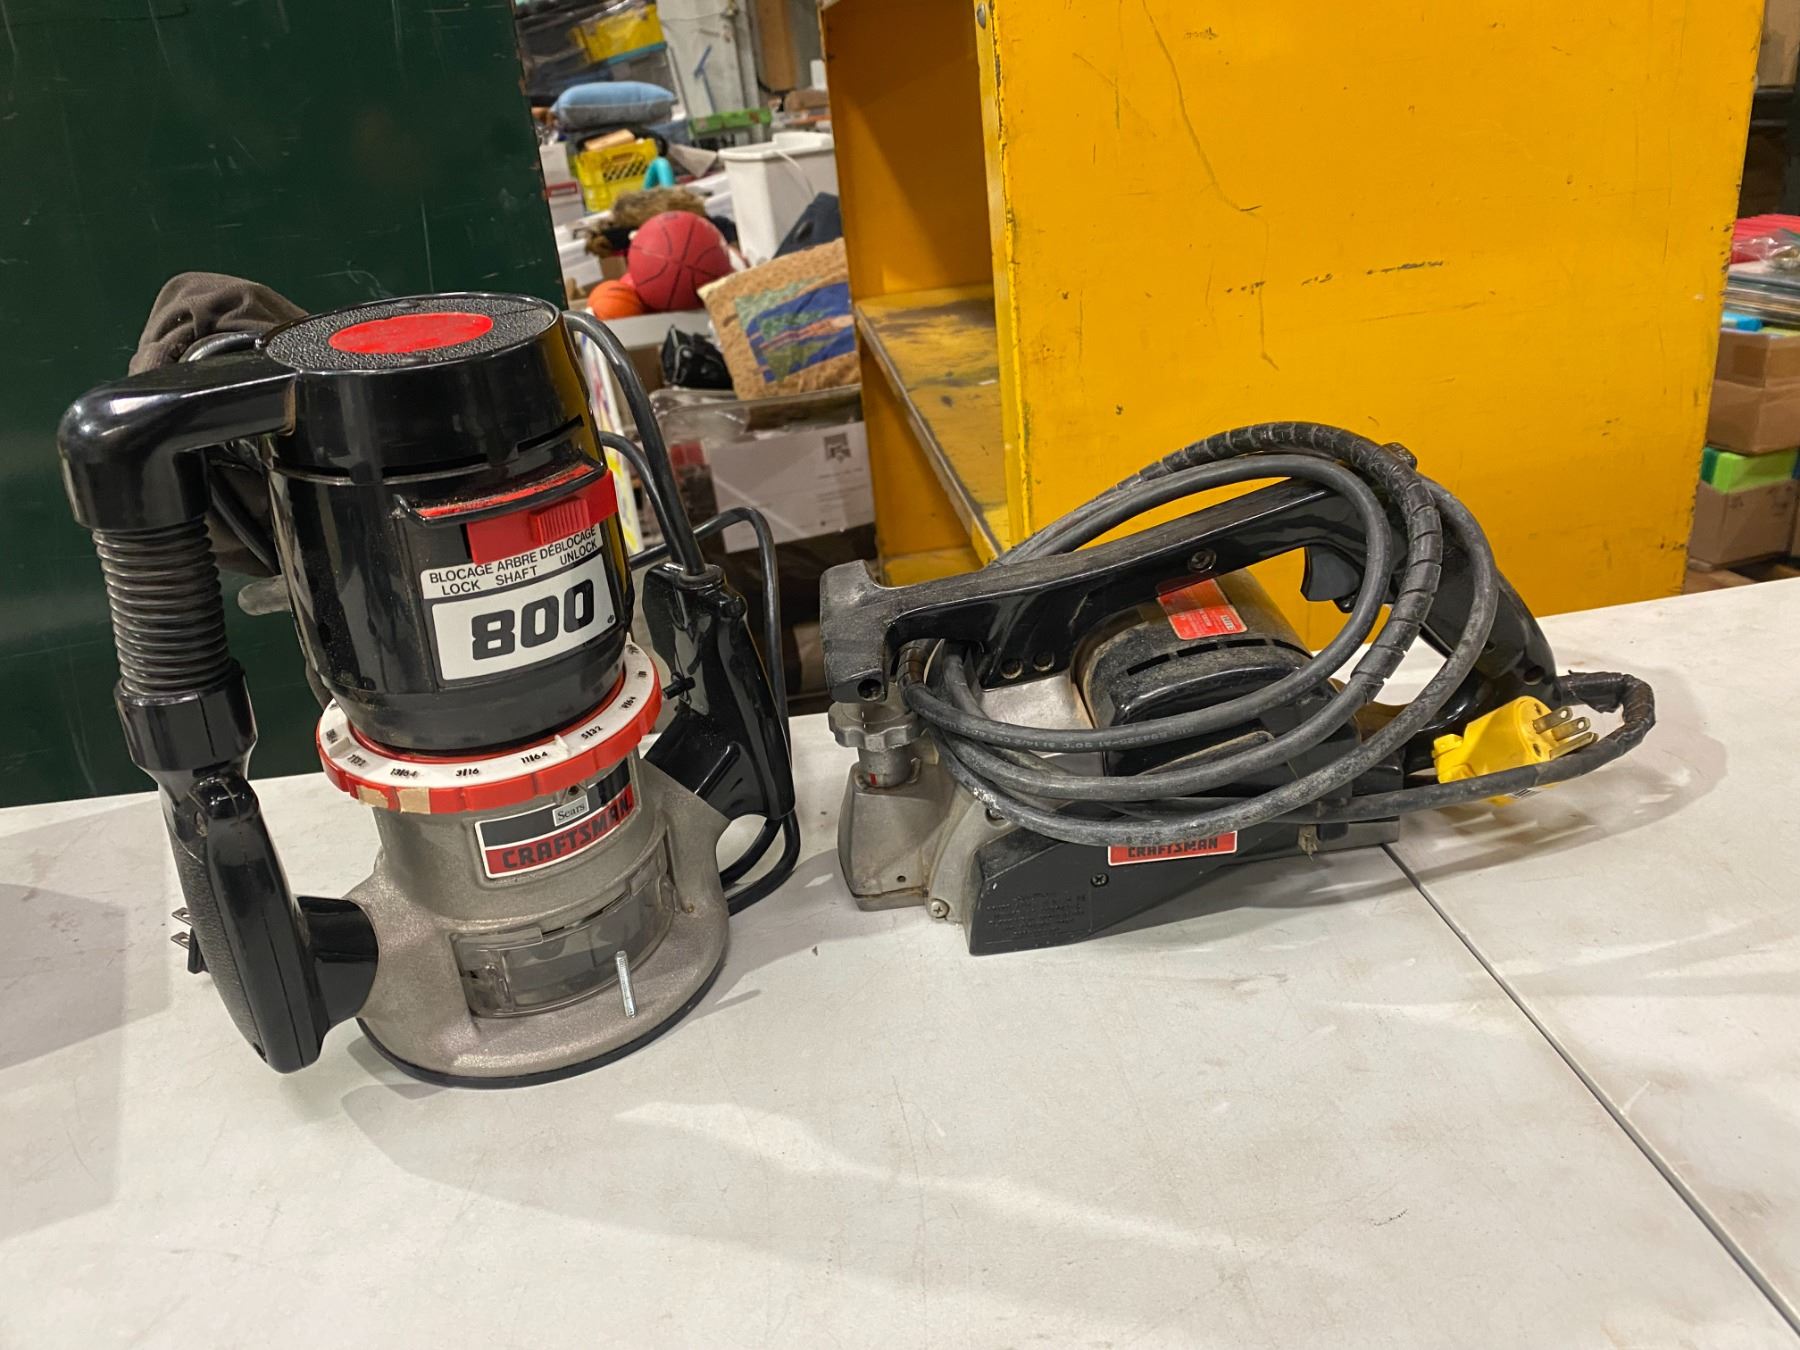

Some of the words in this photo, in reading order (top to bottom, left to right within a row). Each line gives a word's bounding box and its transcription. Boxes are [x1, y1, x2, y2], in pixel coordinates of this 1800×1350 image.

[429, 562, 494, 584] BLOCAGE
[496, 551, 538, 572] ARBRE
[540, 526, 597, 560] DÉBLOCAGE
[441, 579, 481, 596] LOCK
[495, 565, 538, 586] SHAFT
[559, 538, 598, 566] UNLOCK
[471, 579, 595, 661] 800
[502, 793, 630, 869] CRAFTSMAN
[557, 802, 586, 821] Sears
[1127, 837, 1218, 857] CRAFTSMAN
